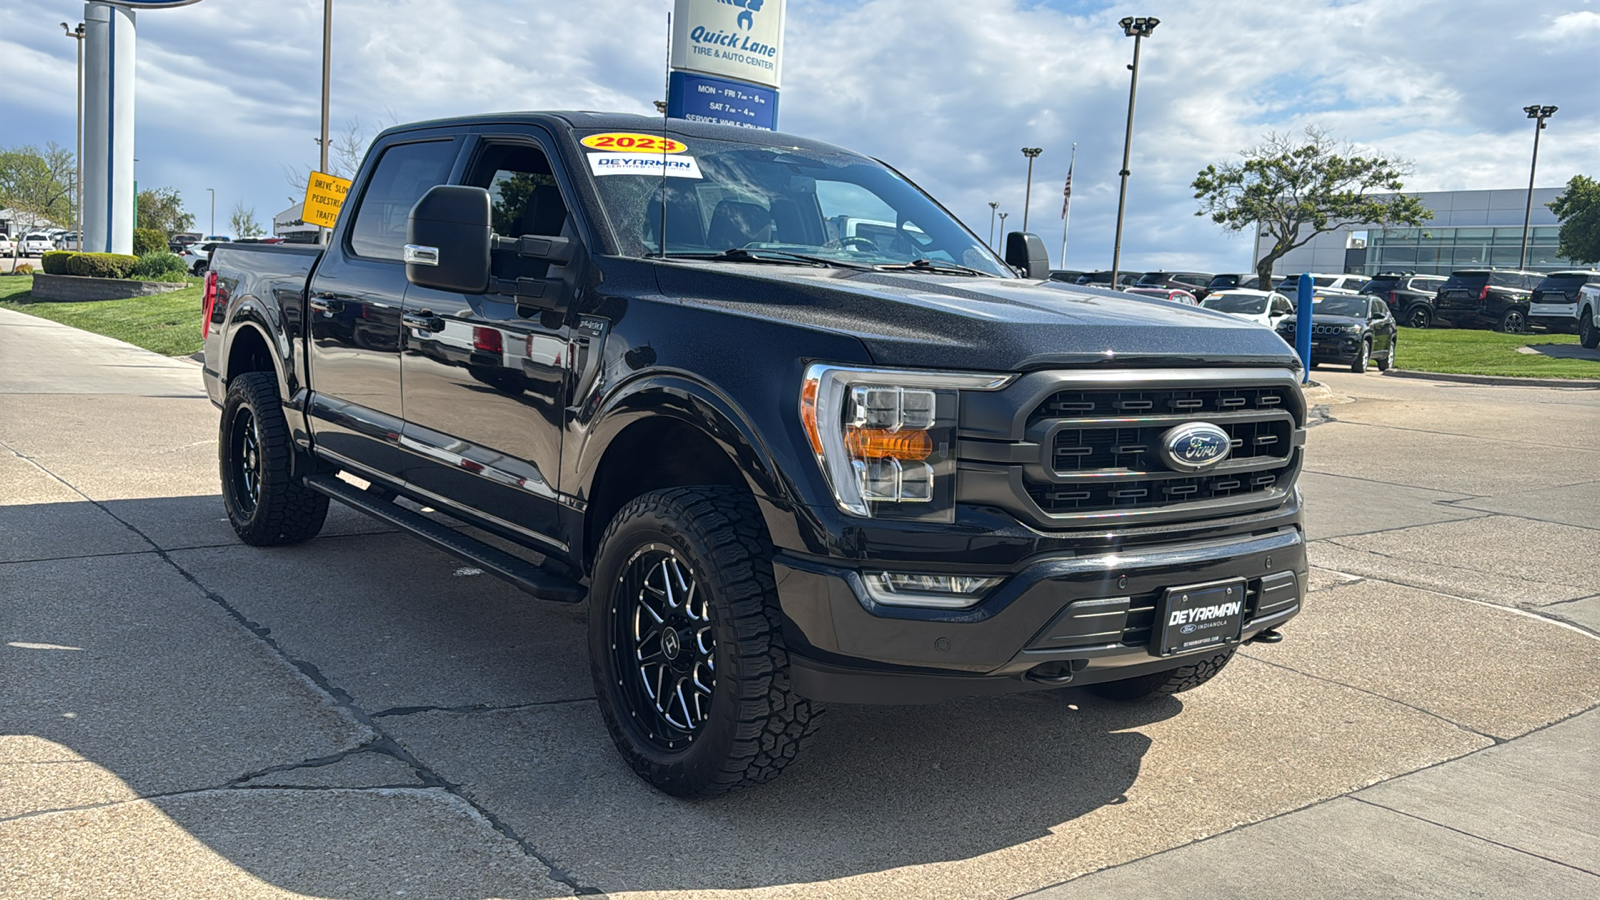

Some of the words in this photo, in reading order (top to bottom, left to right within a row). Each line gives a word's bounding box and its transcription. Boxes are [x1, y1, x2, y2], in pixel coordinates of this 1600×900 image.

[690, 26, 740, 48] Quick
[740, 36, 775, 57] Lane
[692, 46, 712, 56] TIRE
[714, 49, 720, 58] &
[722, 51, 745, 63] AUTO
[746, 56, 774, 70] CENTER
[698, 85, 715, 94] MON
[724, 89, 735, 98] FRI
[709, 102, 723, 110] SAT
[685, 113, 718, 125] SERVICE
[594, 137, 676, 150] 2023
[598, 159, 690, 168] DEYARMAN
[314, 179, 333, 191] DRIVE
[315, 210, 337, 221] TRAFFI
[1185, 436, 1219, 459] Ford
[1168, 601, 1241, 626] DEYARMAN
[1197, 620, 1227, 630] INDIANOLA
